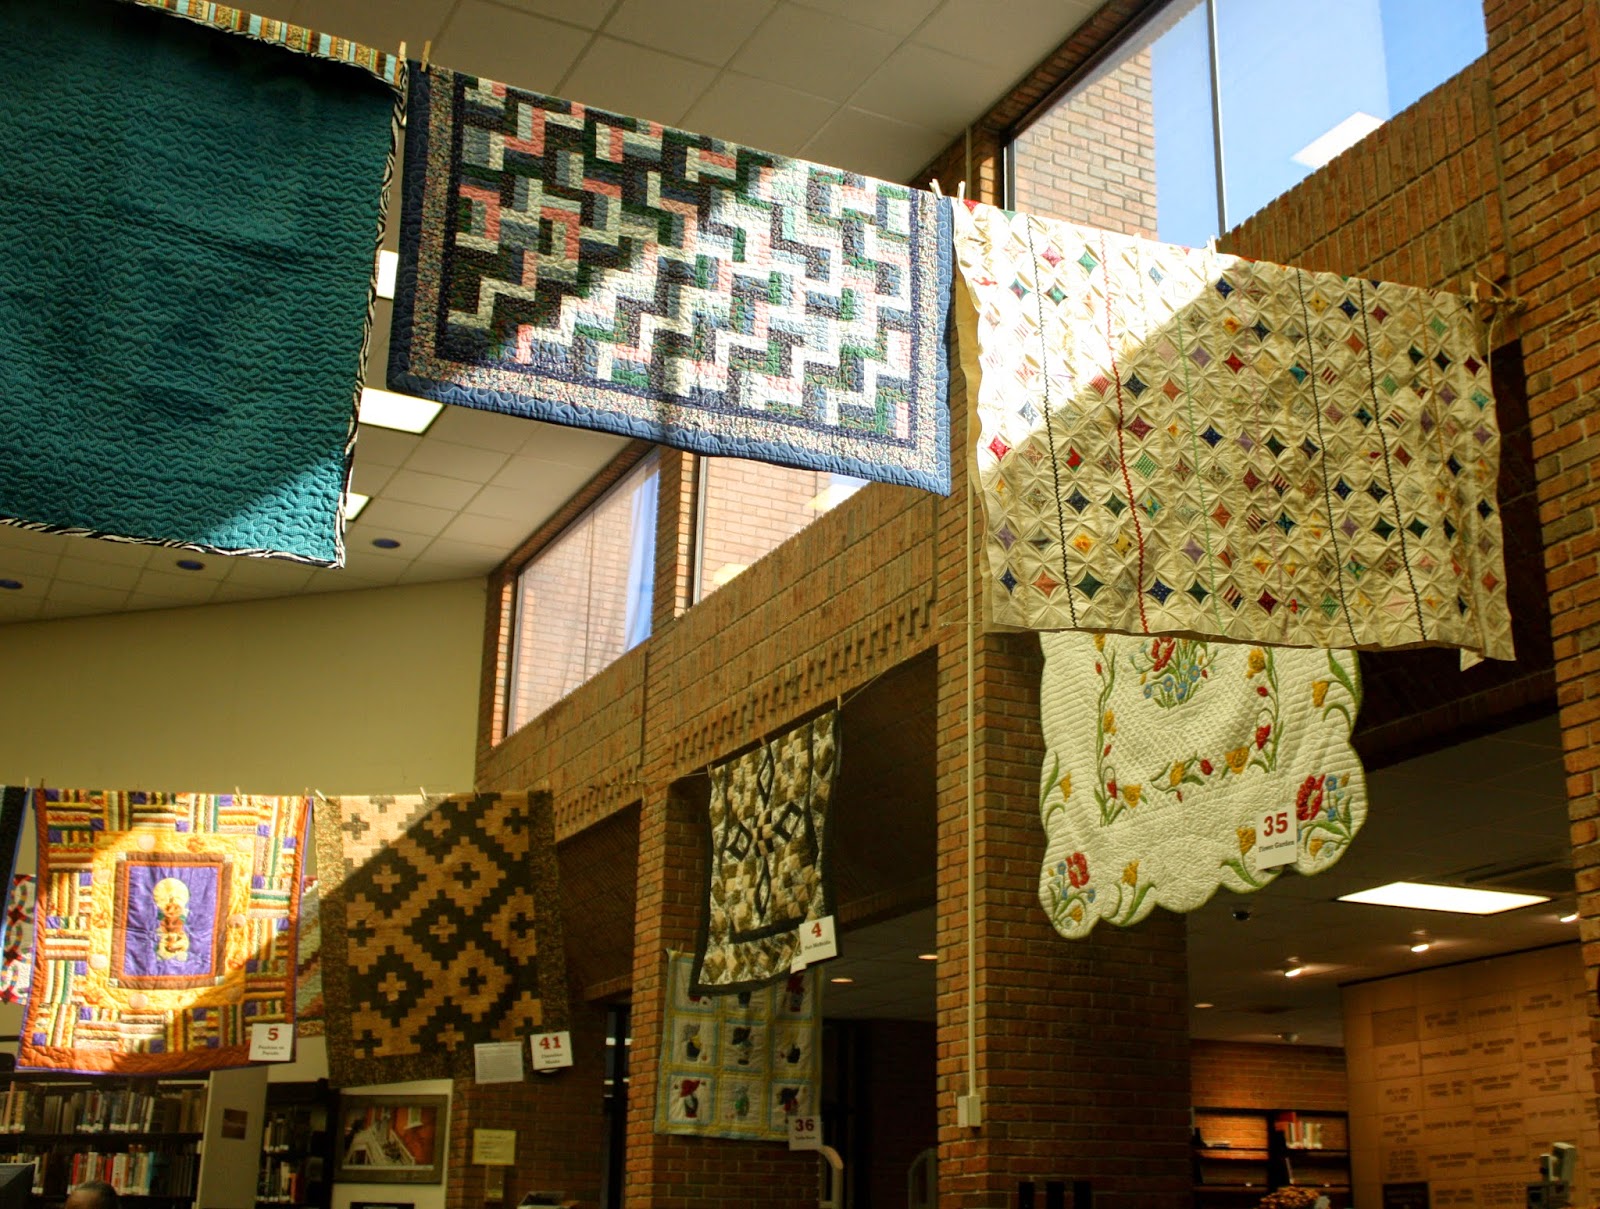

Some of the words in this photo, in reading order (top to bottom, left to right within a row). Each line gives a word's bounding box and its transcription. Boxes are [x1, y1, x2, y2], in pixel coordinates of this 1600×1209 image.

[1264, 812, 1288, 837] 35
[811, 922, 822, 938] 4
[267, 1027, 279, 1041] 5
[539, 1036, 561, 1050] 41
[795, 1118, 815, 1132] 36
